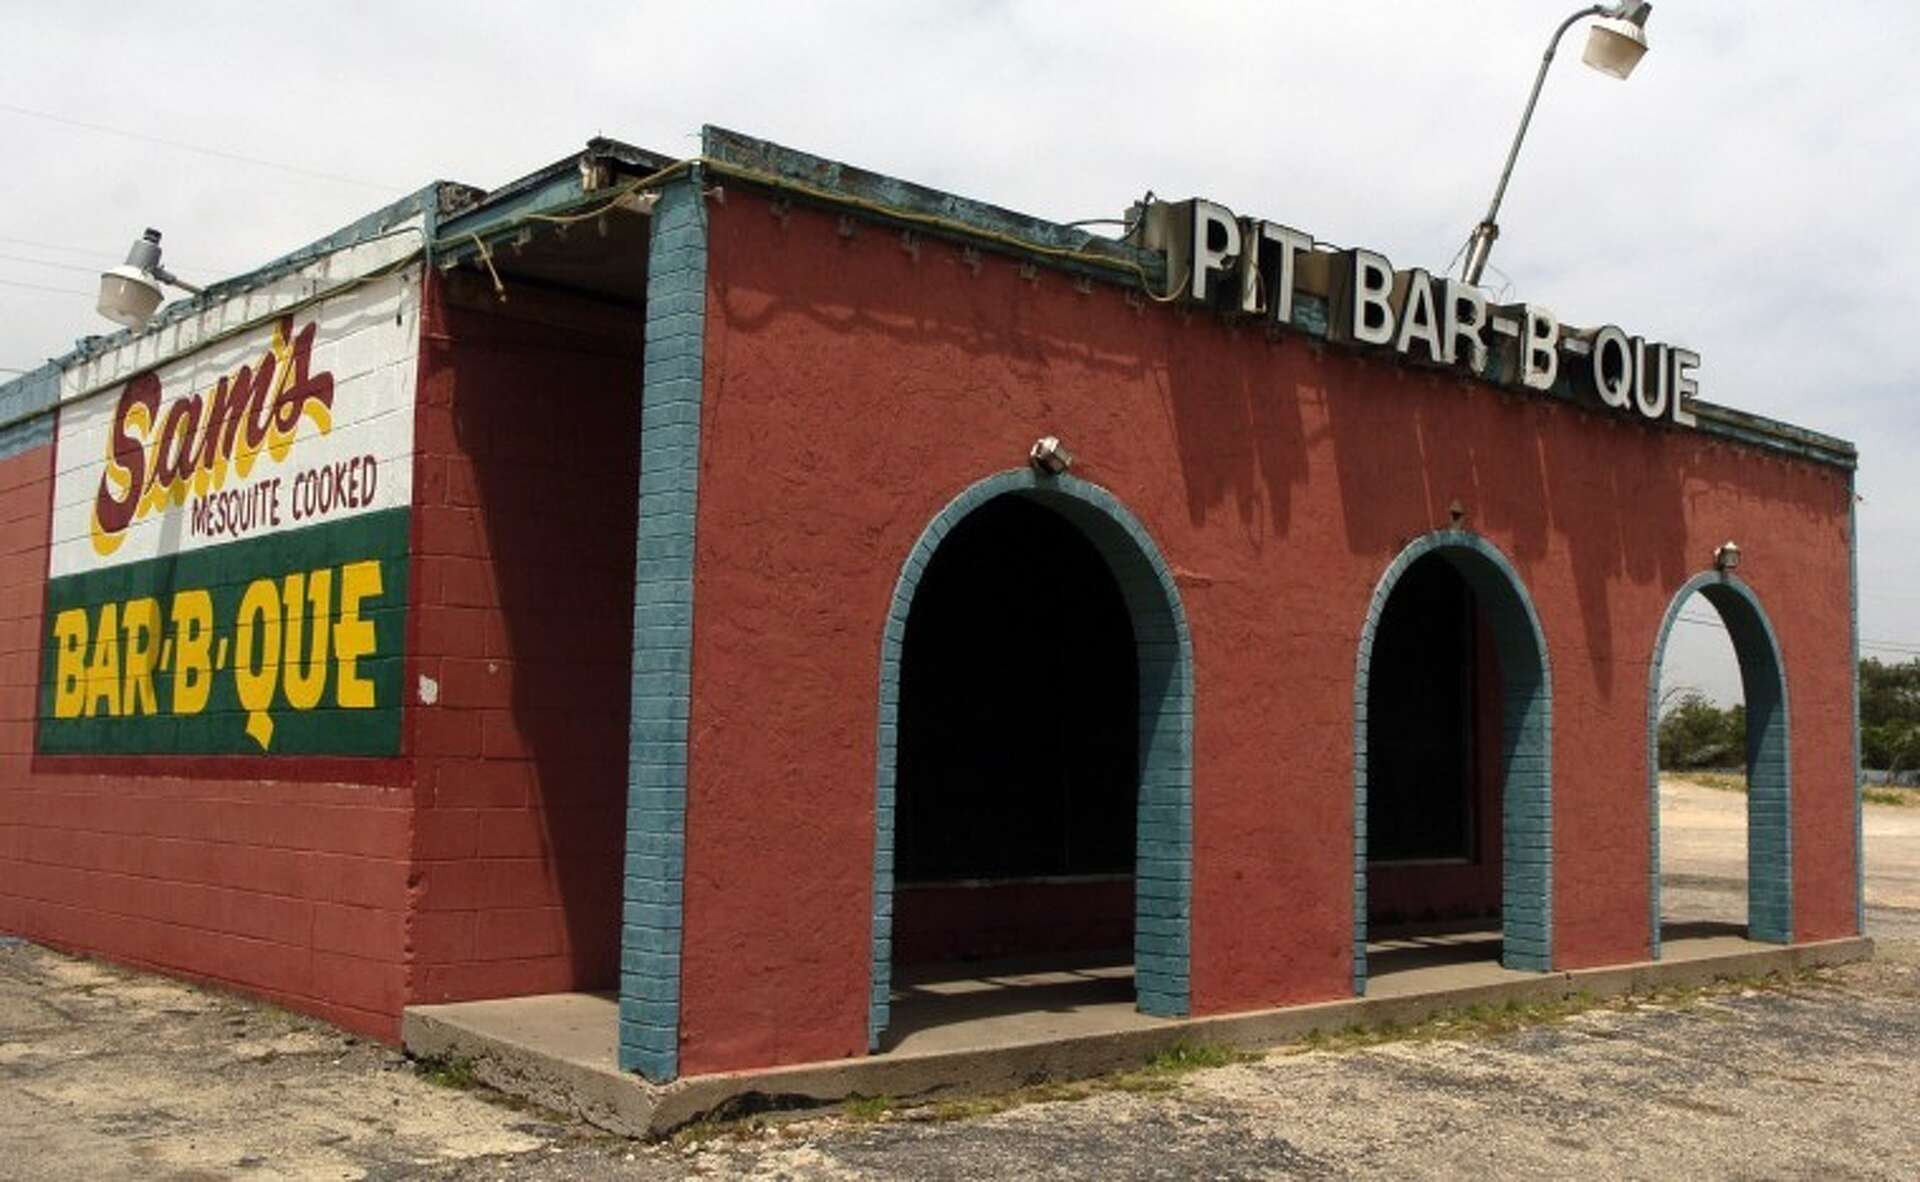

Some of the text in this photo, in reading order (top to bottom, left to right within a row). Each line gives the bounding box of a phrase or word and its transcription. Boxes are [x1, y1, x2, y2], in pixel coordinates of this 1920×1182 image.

[1193, 199, 1700, 428] PIT BAR-B-QUE
[94, 315, 334, 550] Sam's
[191, 453, 377, 538] MESQUITE COOKED
